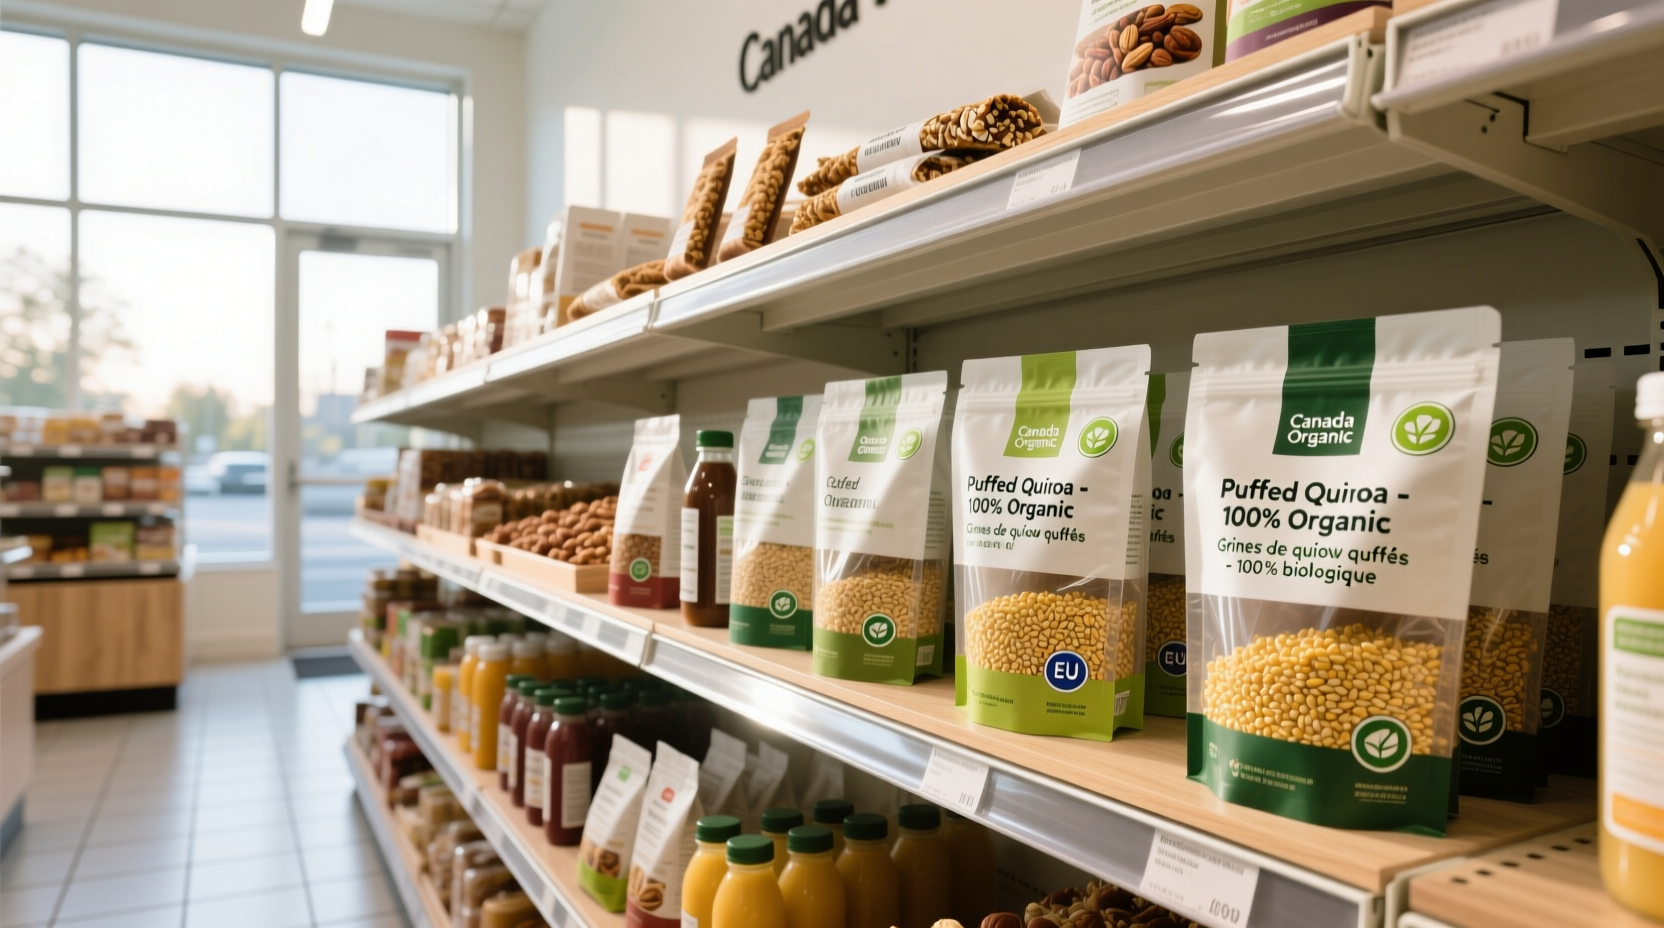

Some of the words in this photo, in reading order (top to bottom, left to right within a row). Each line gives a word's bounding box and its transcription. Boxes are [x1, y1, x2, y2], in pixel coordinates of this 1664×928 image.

[739, 0, 859, 93] Canada
[1290, 411, 1355, 429] Canada
[1286, 429, 1354, 448] Organic
[967, 475, 1018, 493] Puffed
[1220, 478, 1299, 502] Puffed
[969, 497, 1003, 515] 100%
[1007, 498, 1074, 521] Organic
[993, 523, 1007, 537] de
[1223, 506, 1281, 529] 100%
[1288, 509, 1391, 537] Organic
[1217, 537, 1263, 554] Grines
[1266, 540, 1288, 556] de
[1347, 546, 1409, 566] quffés
[1282, 560, 1377, 587] biologique
[1054, 661, 1079, 680] EU
